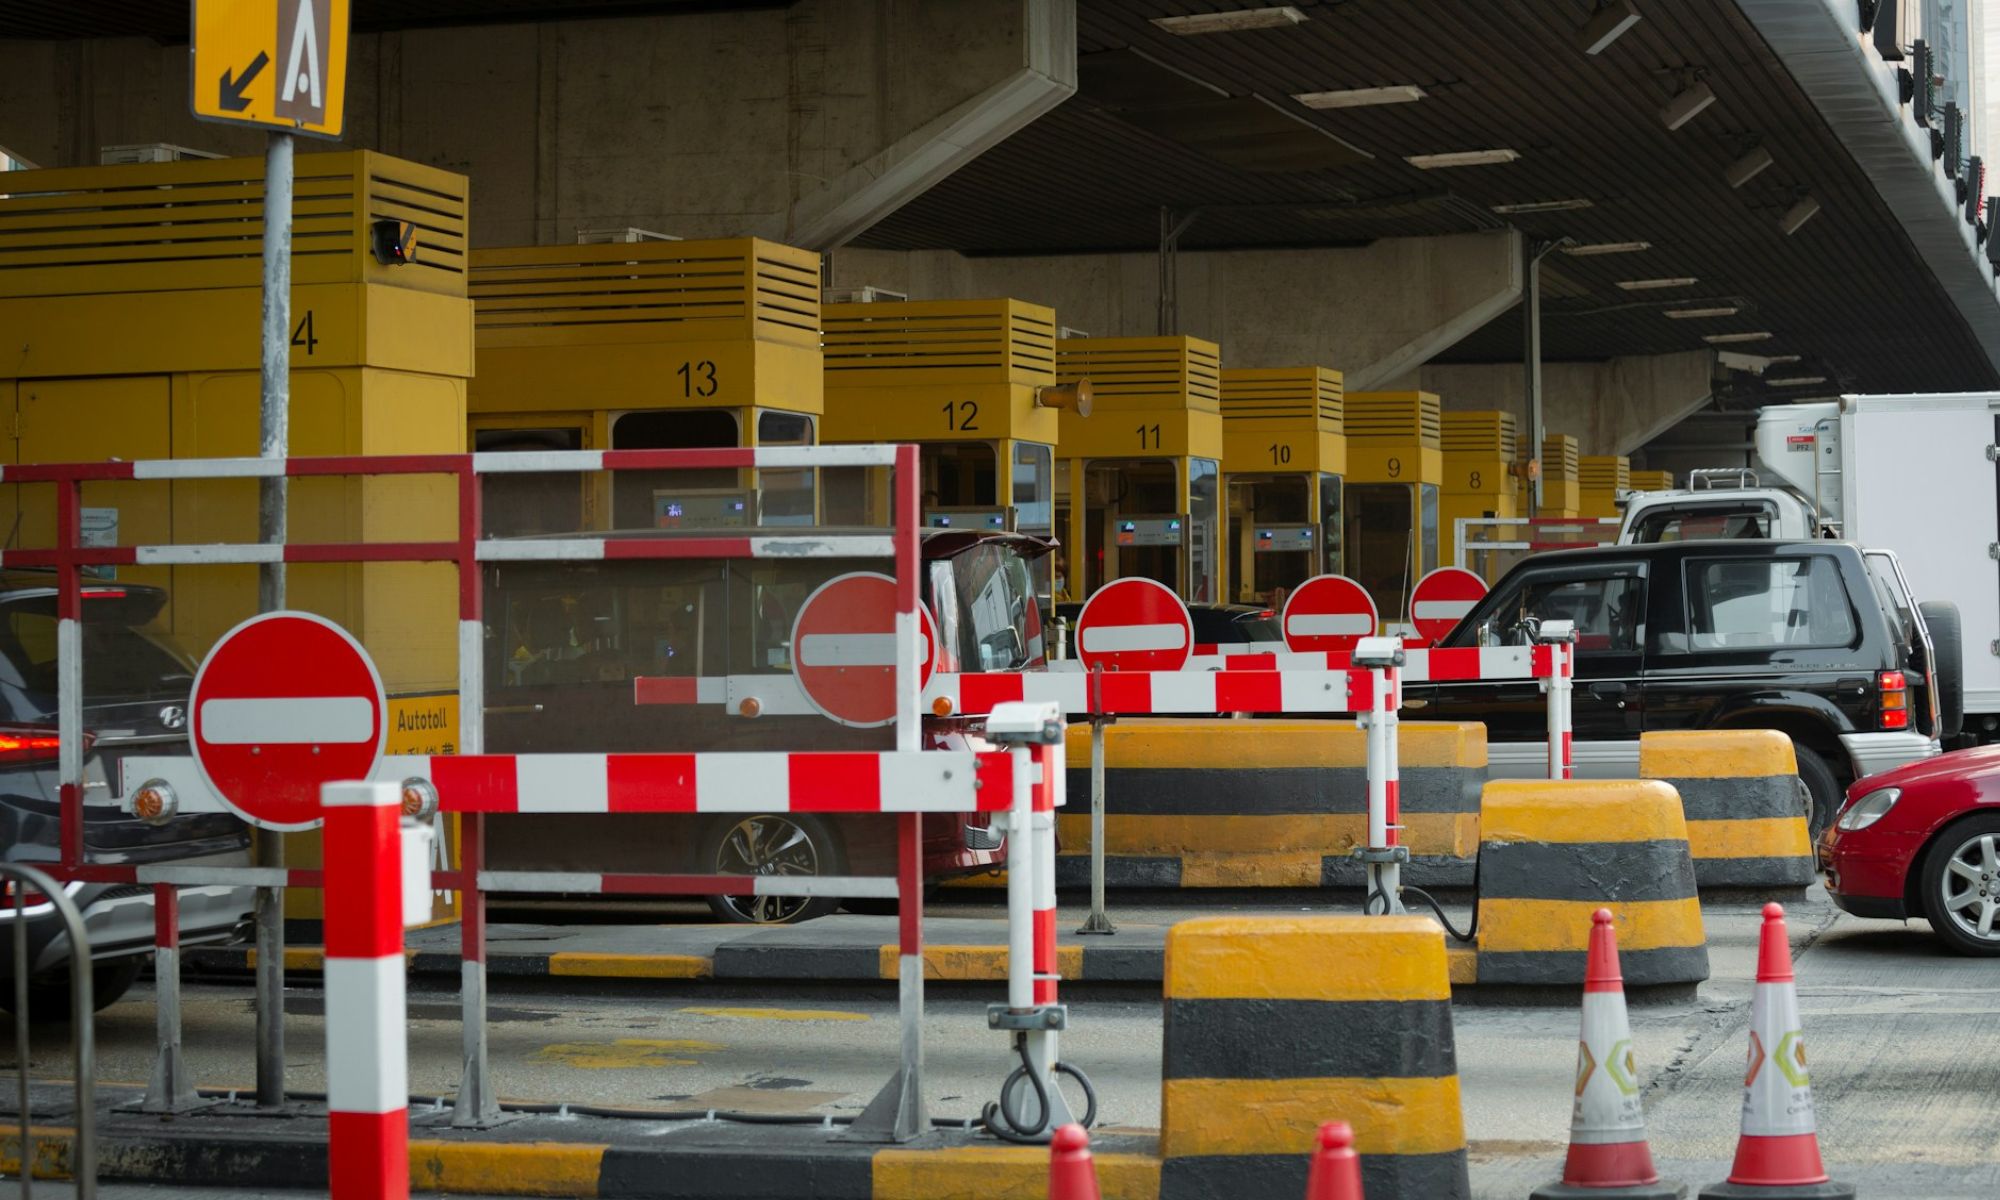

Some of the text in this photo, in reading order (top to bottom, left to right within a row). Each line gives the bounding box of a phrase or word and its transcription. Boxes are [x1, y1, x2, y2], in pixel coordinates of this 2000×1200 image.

[677, 360, 718, 398] 13
[942, 400, 979, 431] 12
[1136, 424, 1161, 450] 11
[1269, 444, 1291, 466] 10
[1387, 458, 1401, 478] 9
[1469, 471, 1482, 489] 8
[397, 707, 447, 732] Autotoll
